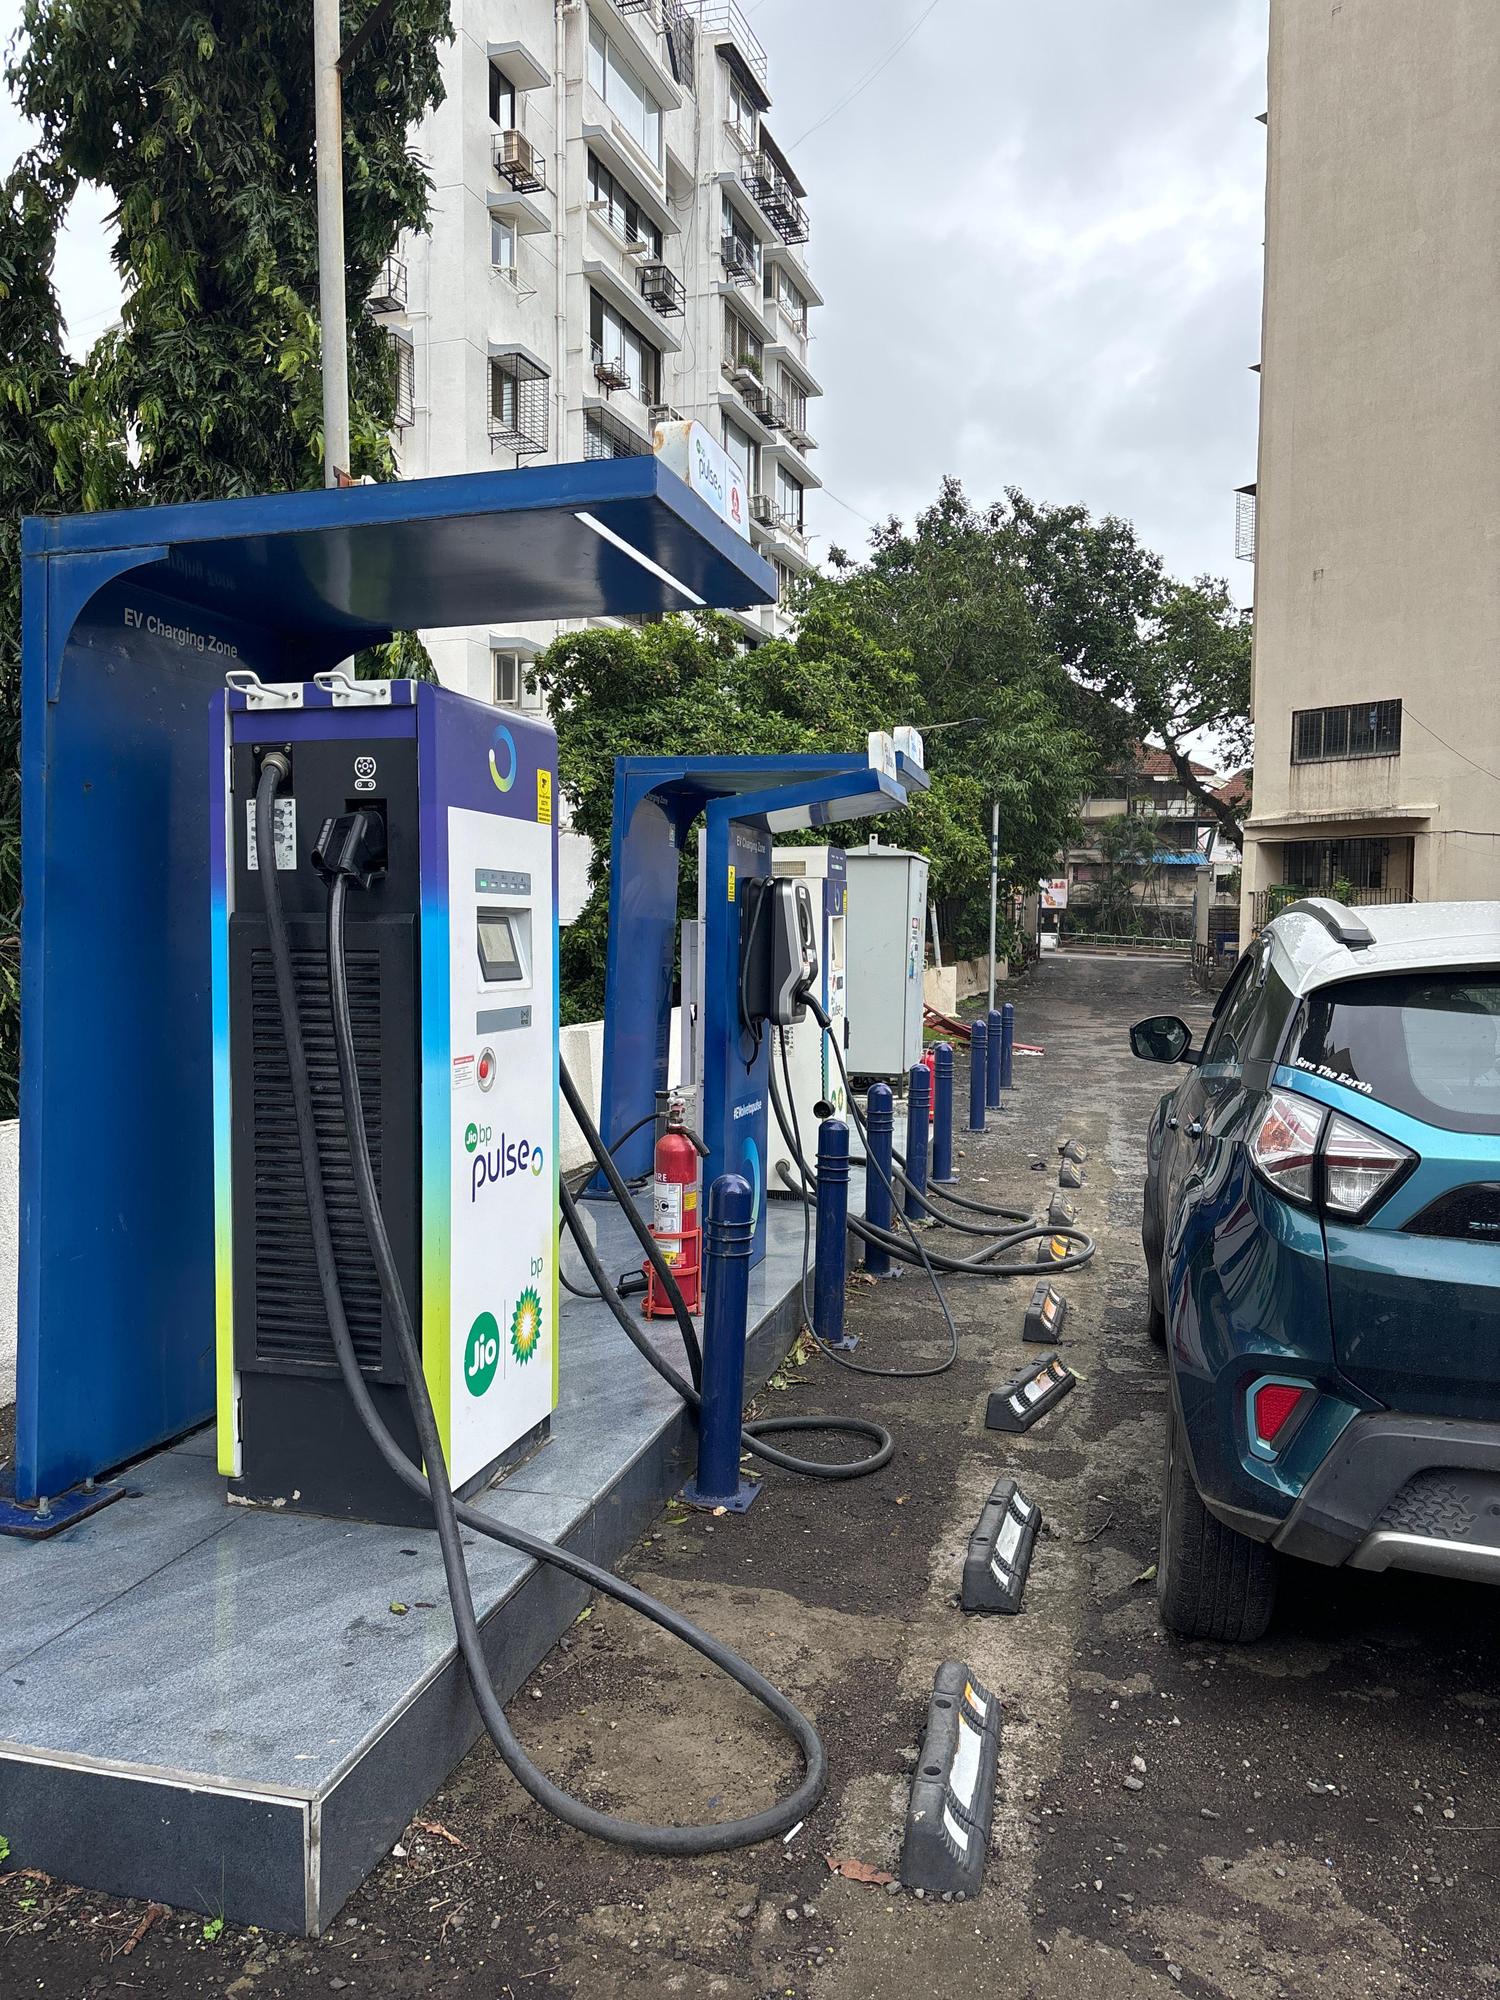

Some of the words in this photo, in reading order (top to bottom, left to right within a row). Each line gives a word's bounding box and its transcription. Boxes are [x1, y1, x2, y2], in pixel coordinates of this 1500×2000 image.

[124, 607, 143, 629] EV
[146, 615, 205, 652] Charging
[207, 635, 238, 658] Zone
[1295, 1057, 1316, 1071] Save
[1316, 1064, 1338, 1079] The
[1336, 1072, 1374, 1094] Earth
[479, 1124, 492, 1147] bp
[471, 1132, 530, 1203] pulse
[530, 1256, 544, 1279] bp
[468, 1333, 497, 1377] Jio
